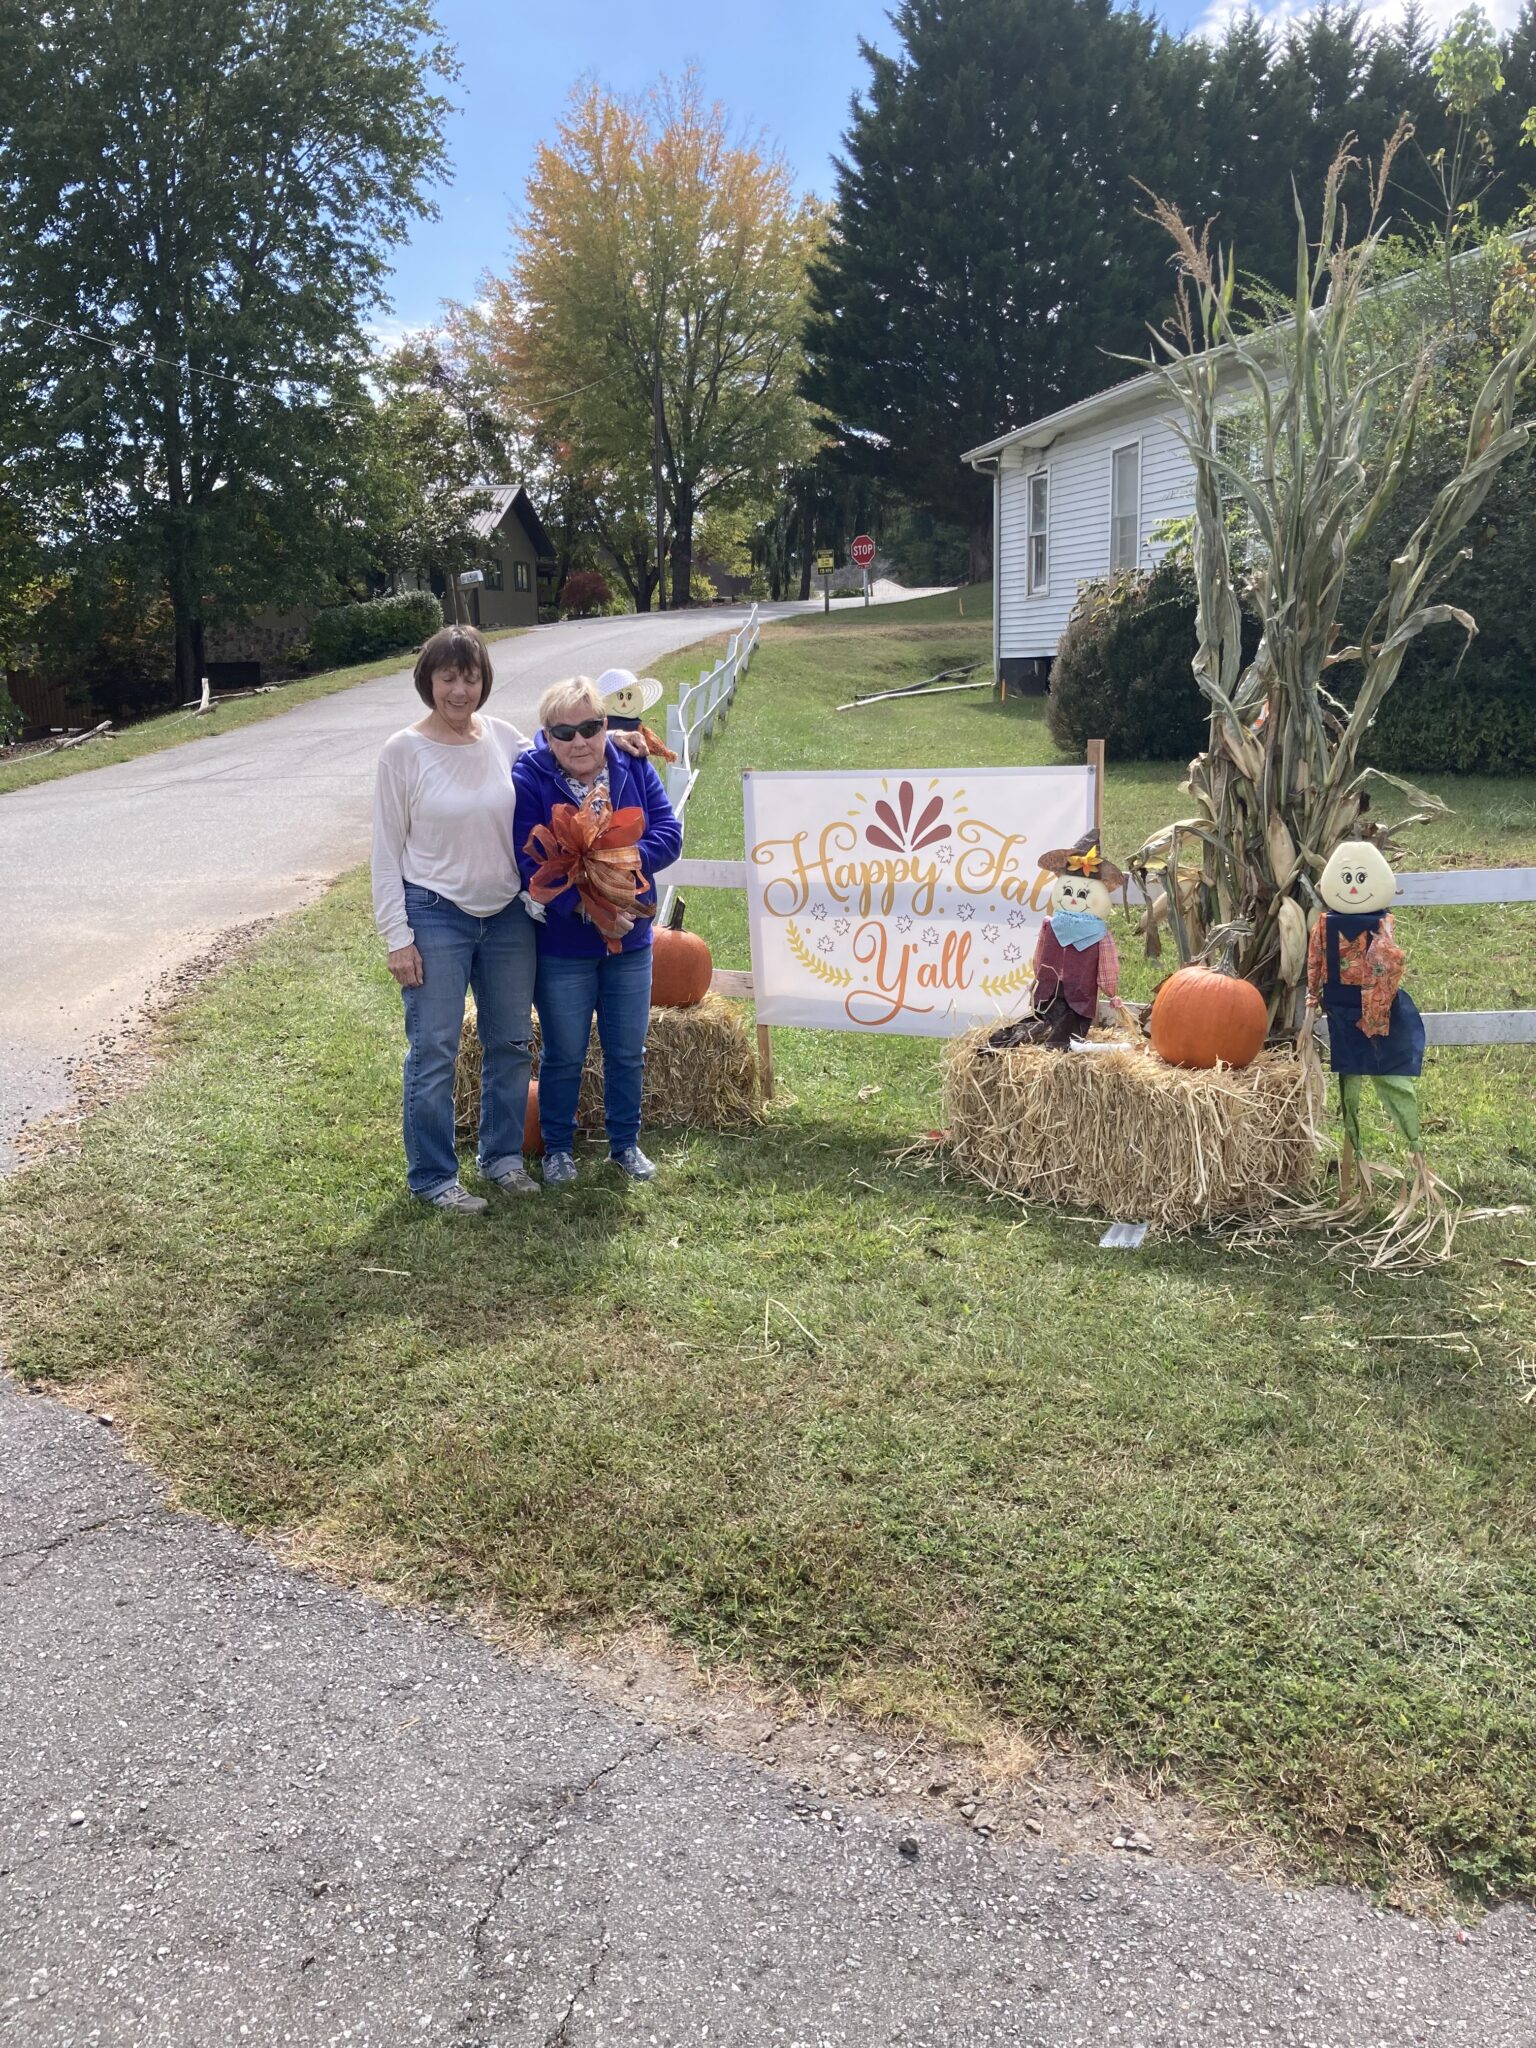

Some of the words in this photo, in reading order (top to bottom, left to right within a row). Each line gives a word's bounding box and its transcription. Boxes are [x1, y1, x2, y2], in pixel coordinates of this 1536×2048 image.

[853, 544, 874, 557] STOP
[751, 821, 943, 919] Happy
[954, 820, 1055, 917] Fal
[846, 921, 974, 1026] Y'all
